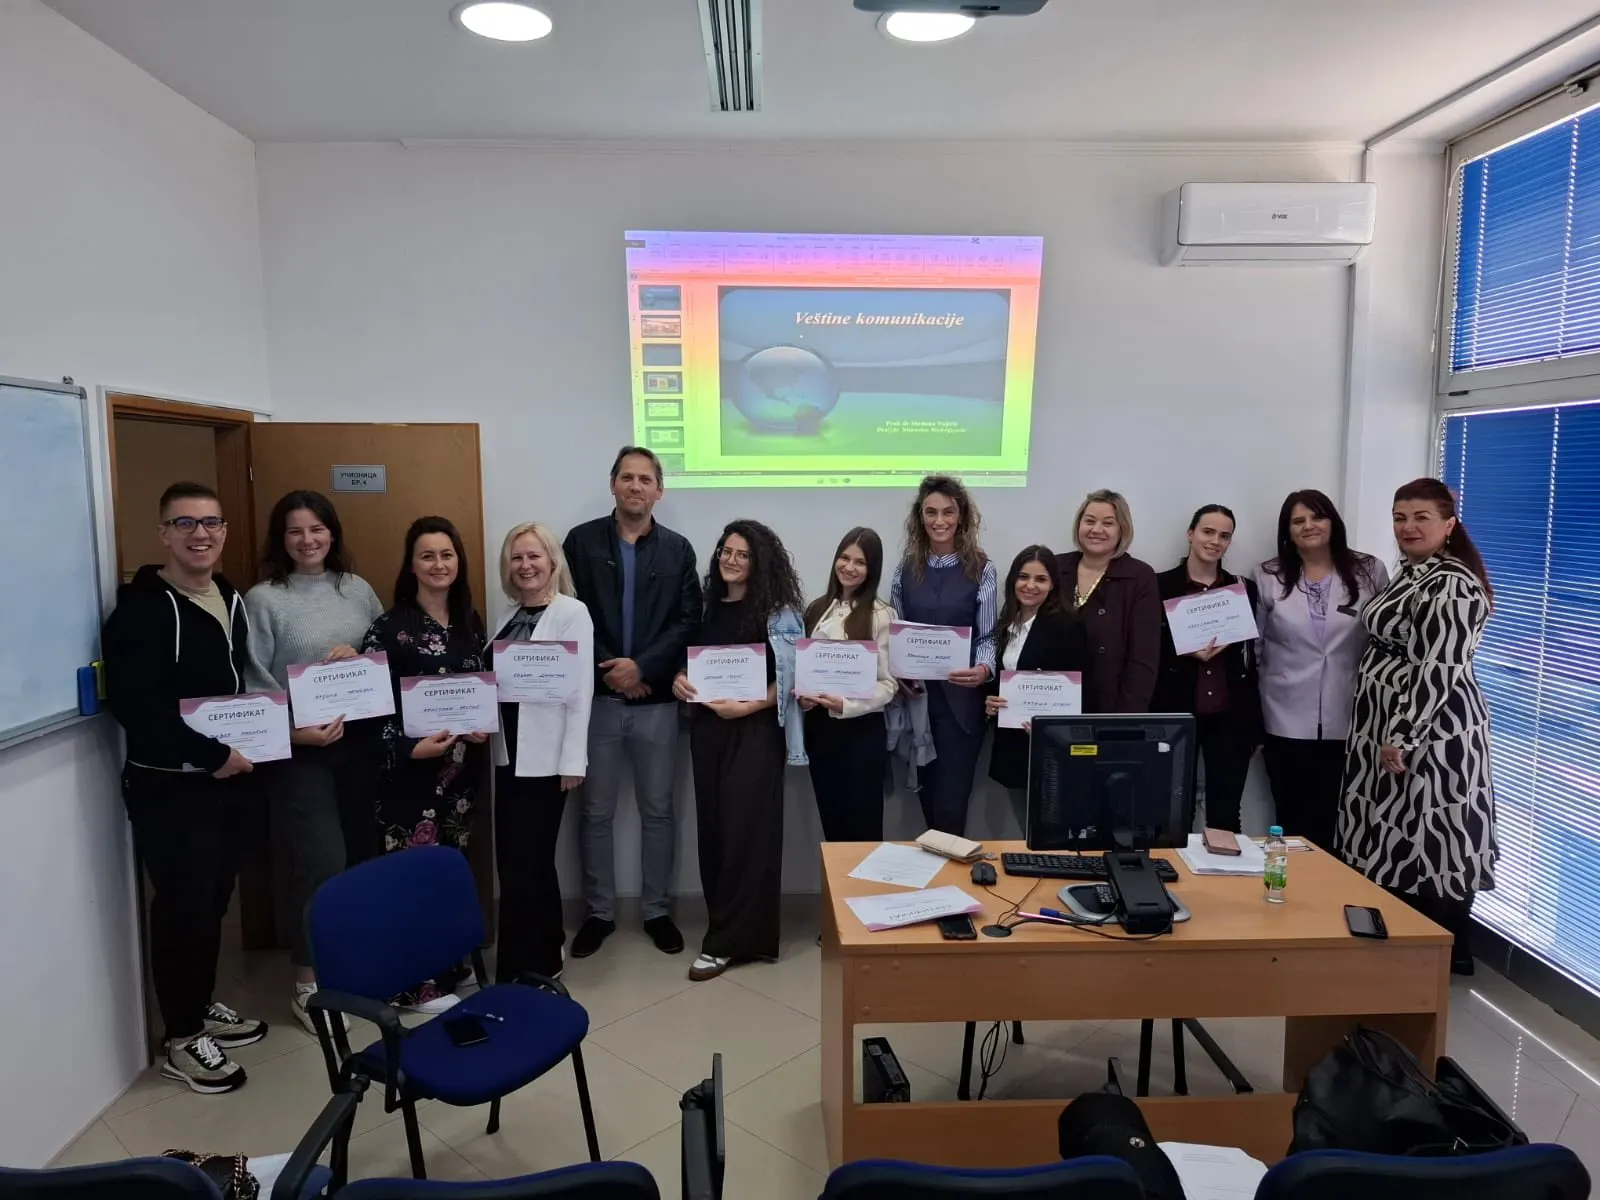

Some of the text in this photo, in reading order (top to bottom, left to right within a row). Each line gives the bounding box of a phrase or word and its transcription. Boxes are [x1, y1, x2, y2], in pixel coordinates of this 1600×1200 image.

[795, 311, 964, 328] Veštine komunikacije
[1186, 600, 1230, 614] СЕРТИФИКАТ
[906, 637, 951, 645] СЕРТИФИКАТ
[706, 656, 749, 665] СЕРТИФИКАТ
[815, 652, 860, 660] СЕРТИФИКАТ
[313, 669, 367, 683] СЕРТИФИКАТ
[424, 687, 476, 697] СЕРТИФИКАТ
[208, 708, 265, 721] СЕРТИФИКАТ
